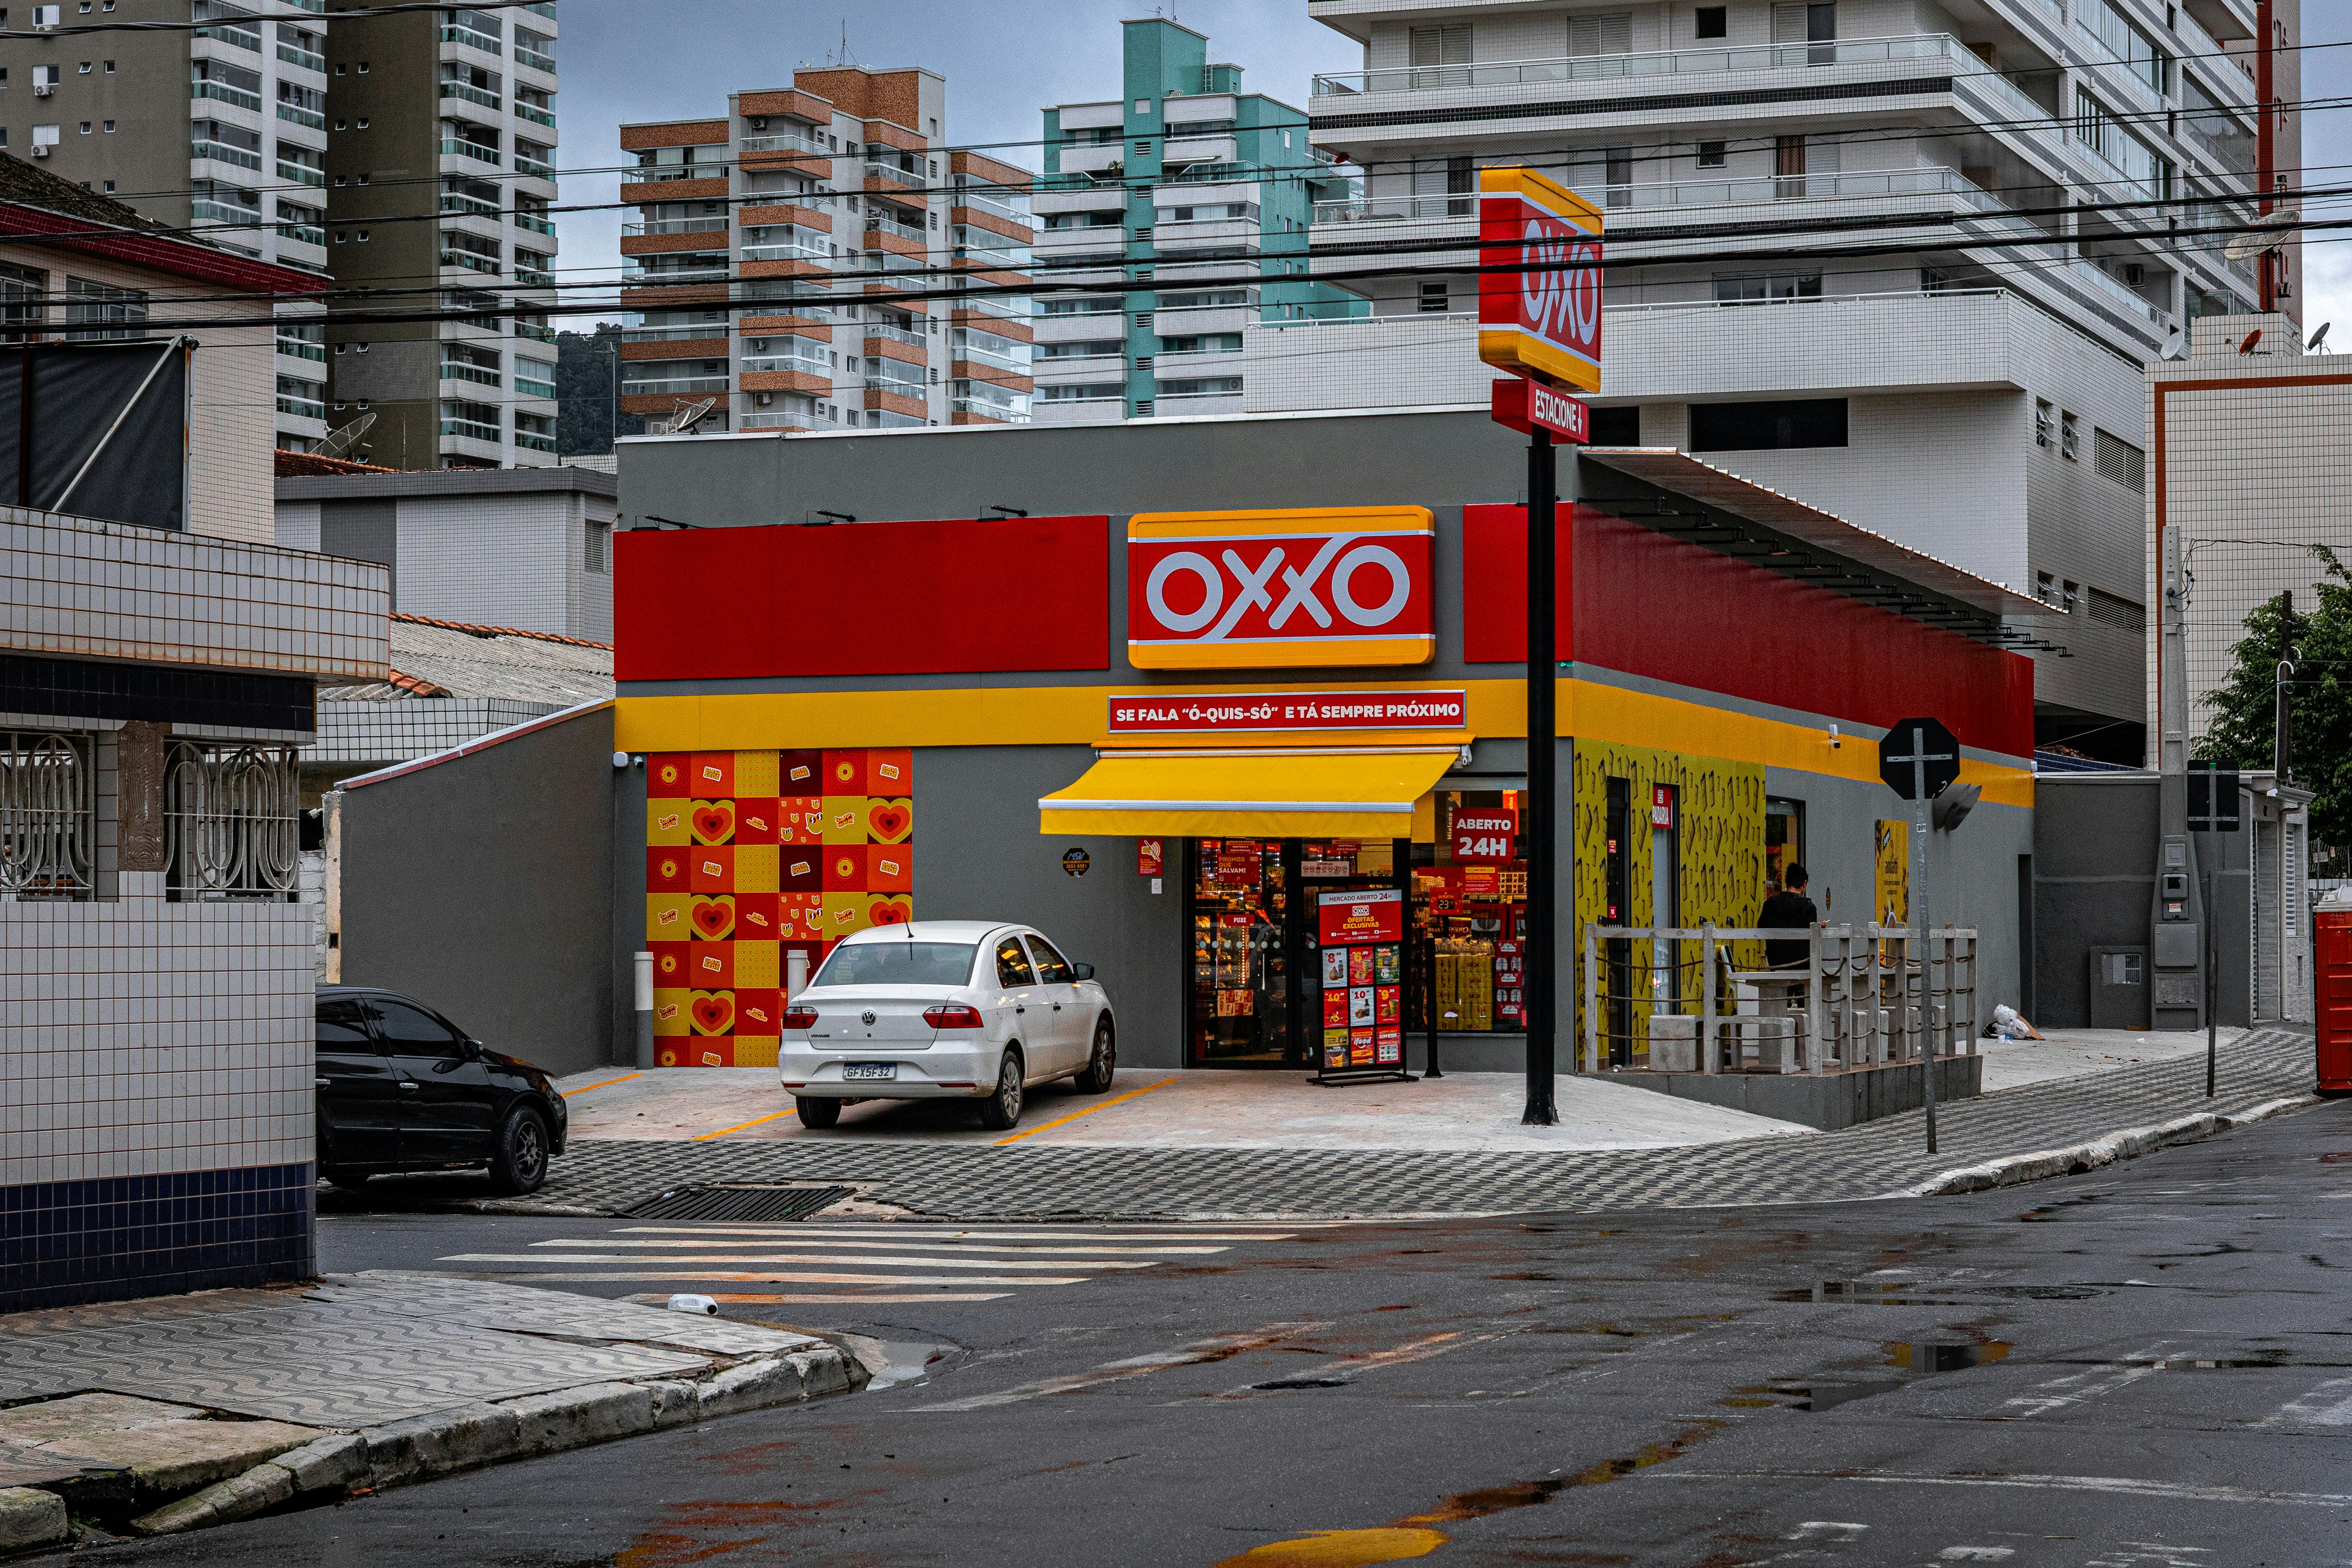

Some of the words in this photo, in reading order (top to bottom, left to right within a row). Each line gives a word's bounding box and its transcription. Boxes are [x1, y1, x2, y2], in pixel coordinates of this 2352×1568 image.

[1522, 219, 1597, 345] OXXO
[1535, 389, 1577, 431] ESTACIONE
[1147, 534, 1410, 641] OXXO
[1117, 709, 1135, 721] SE
[1138, 709, 1179, 721] FALA
[1285, 706, 1294, 718] E
[1297, 702, 1318, 718] TÁ
[1321, 706, 1383, 718] SEMPRE
[1387, 701, 1460, 717] PRÓXIMO
[1456, 818, 1512, 831] ABERTO
[1653, 805, 1669, 825] PADARIA
[1459, 837, 1507, 856] 24H
[847, 1068, 890, 1077] GFX5F32
